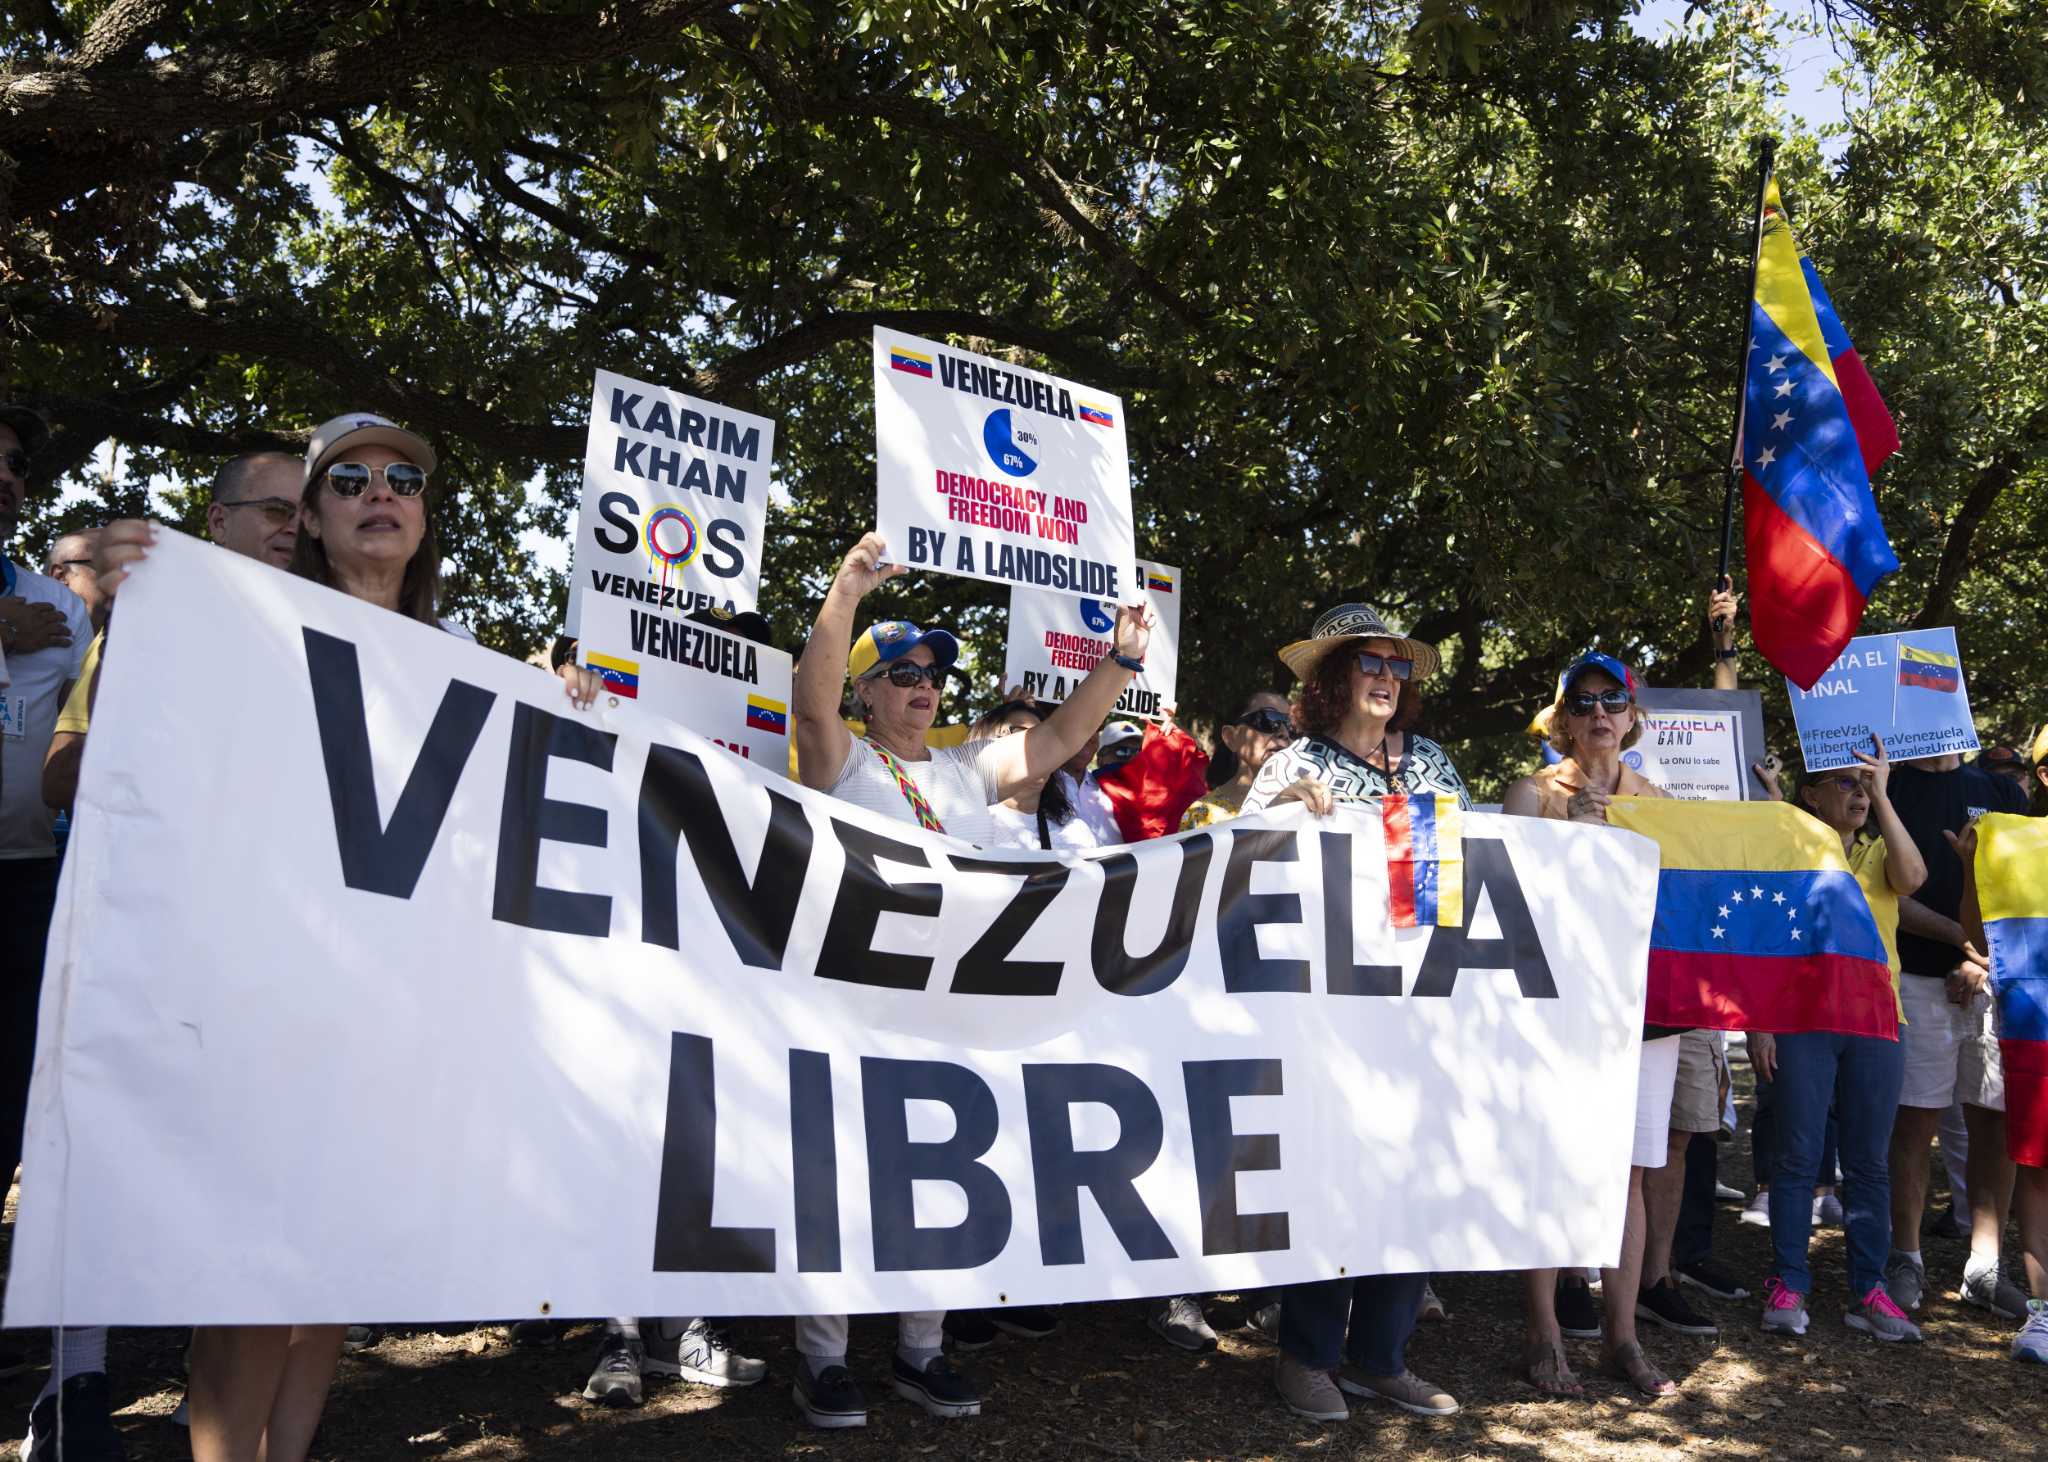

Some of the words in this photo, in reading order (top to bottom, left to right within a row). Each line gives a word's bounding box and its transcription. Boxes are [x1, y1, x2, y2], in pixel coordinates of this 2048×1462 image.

[938, 354, 1075, 421] VENEZUELA
[610, 388, 760, 461] KARIM
[1017, 431, 1037, 445] 30%
[614, 437, 746, 503] KHAN
[1003, 453, 1024, 469] 67%
[936, 469, 1047, 515] DEMOCRACY
[1054, 496, 1088, 523] AND
[594, 491, 746, 578] SOS
[949, 497, 1031, 535] FREEDOM
[1037, 515, 1079, 545] WON
[908, 526, 946, 566] BY
[956, 536, 975, 573] A
[985, 541, 1119, 599] LANDSLIDE
[630, 609, 758, 685] VENEZUELA
[1045, 631, 1115, 657] DEMOCRAC
[1865, 651, 1888, 667] EL
[1051, 650, 1102, 672] FREEDO
[1053, 676, 1066, 701] A
[1645, 716, 1727, 732] NEZUELA
[1803, 724, 1870, 742] #FreeVzla
[1805, 726, 1964, 756] #LibertadPraVenezuela
[1660, 757, 1669, 765] La
[1672, 757, 1692, 765] ONU
[1694, 757, 1701, 765] lo
[1664, 783, 1694, 791] UNION
[1697, 784, 1730, 793] europea
[302, 626, 1559, 999] VENEZUELA
[652, 1031, 1290, 1273] LIBRE
